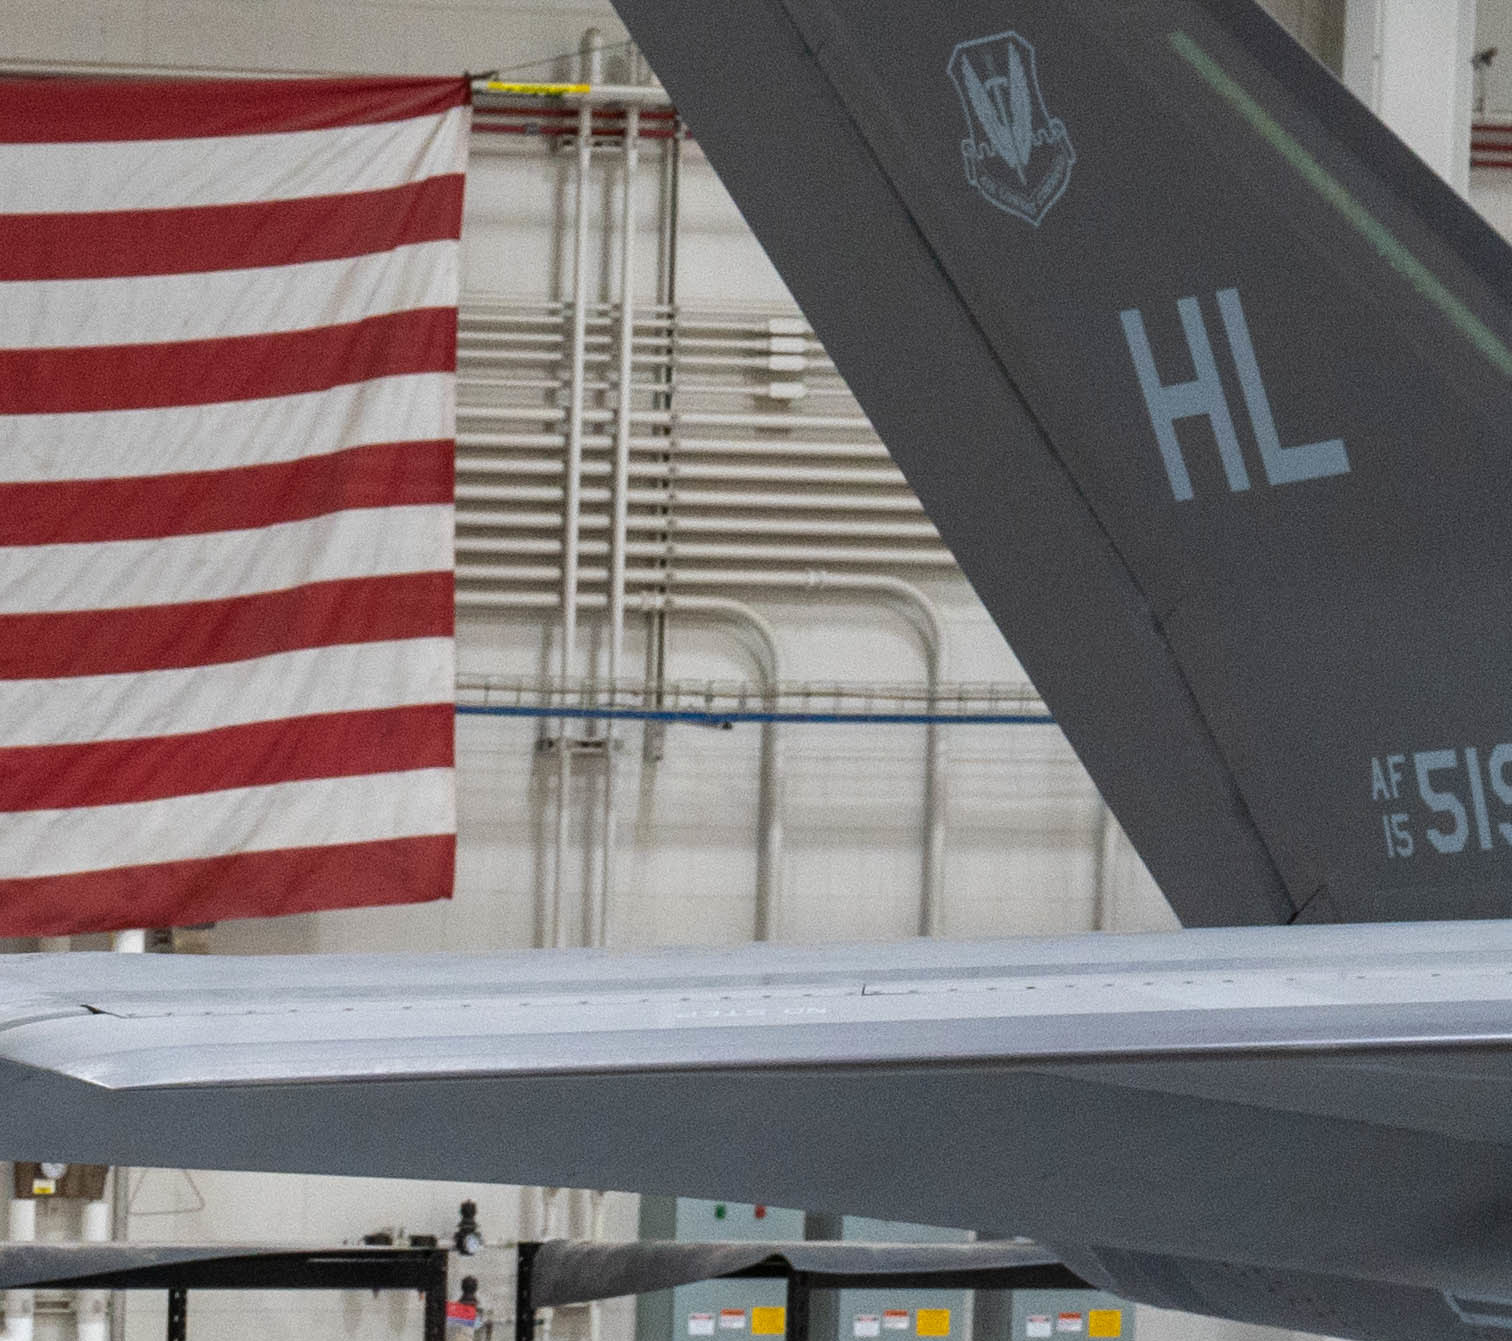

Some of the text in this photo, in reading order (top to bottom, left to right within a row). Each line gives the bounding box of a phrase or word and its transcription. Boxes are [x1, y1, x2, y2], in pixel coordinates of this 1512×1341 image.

[1120, 288, 1351, 501] HL
[1371, 754, 1406, 800] AF
[1382, 812, 1413, 858] 15
